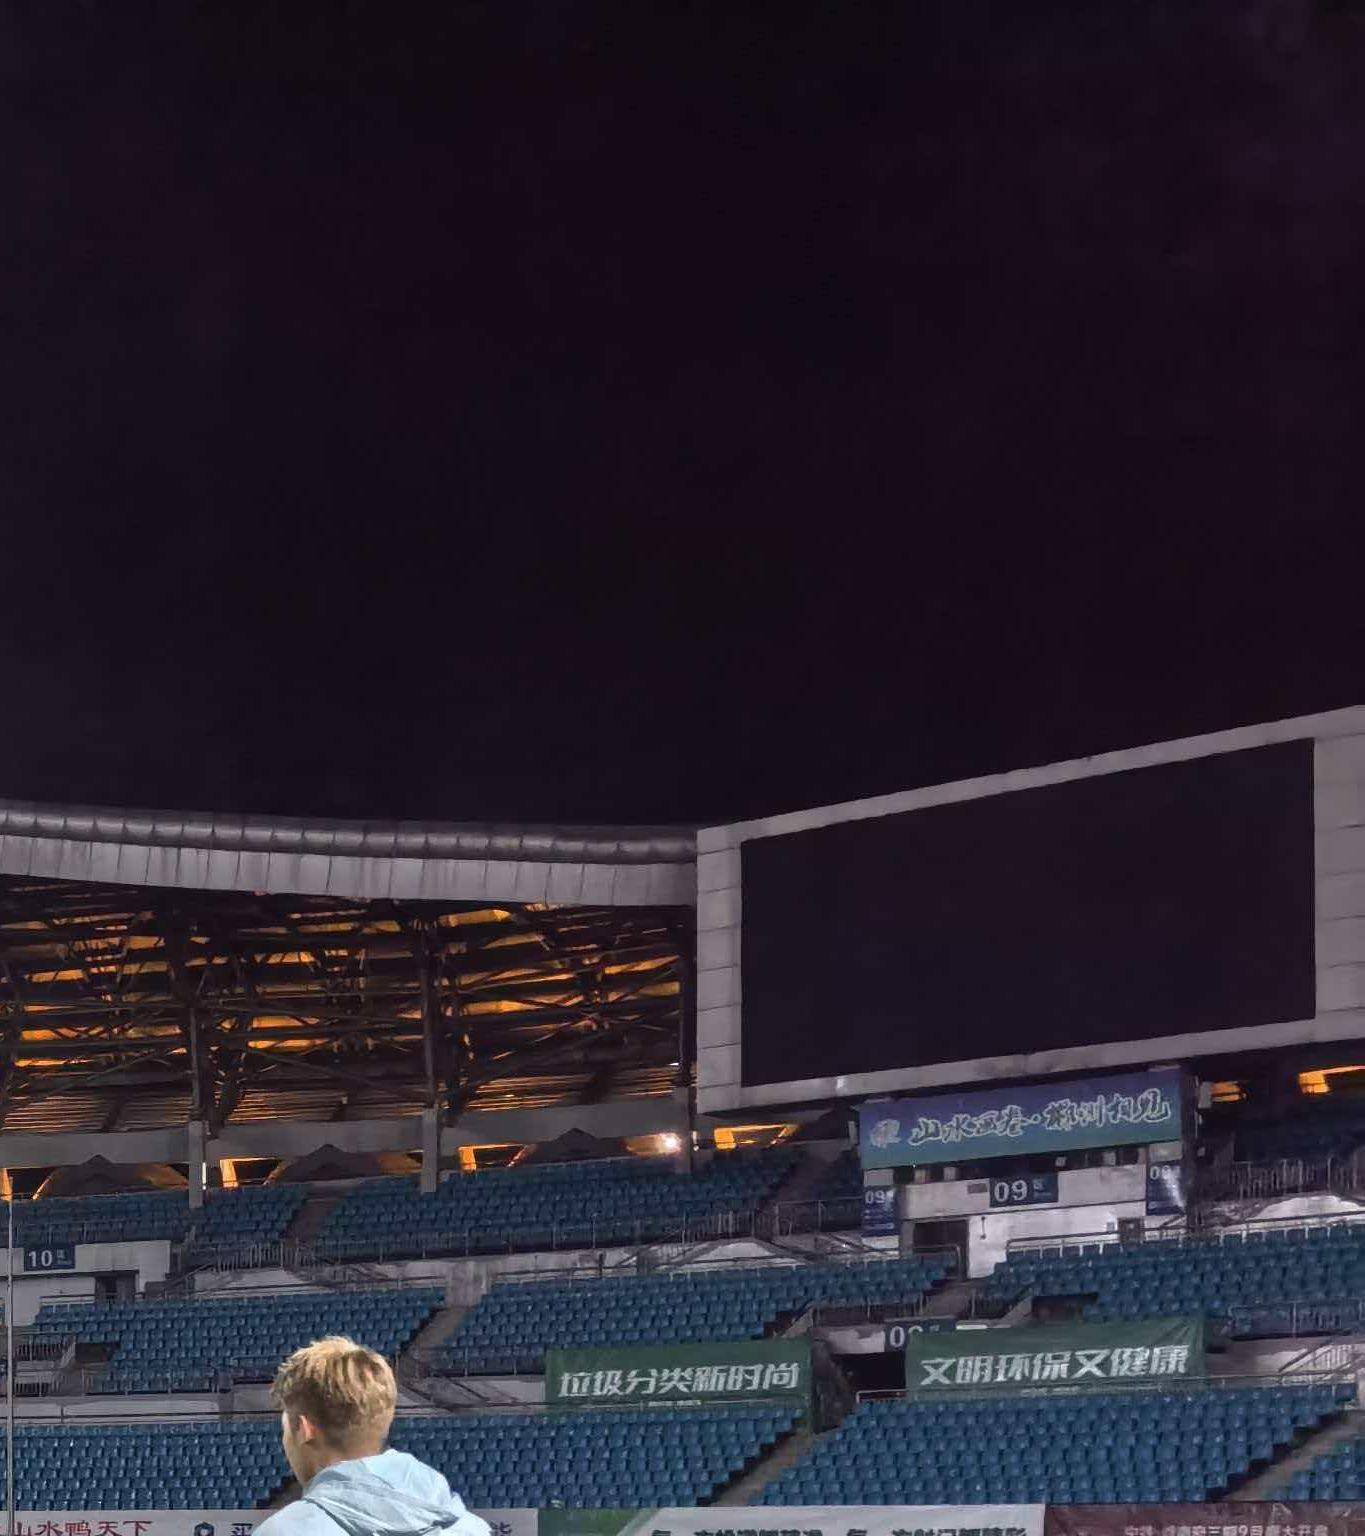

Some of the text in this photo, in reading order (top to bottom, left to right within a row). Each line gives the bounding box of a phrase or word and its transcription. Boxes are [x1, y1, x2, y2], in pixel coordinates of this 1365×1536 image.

[994, 1180, 1028, 1201] 09
[29, 1250, 53, 1267] 10
[920, 1345, 1189, 1386] 文明环保又健康
[558, 1362, 800, 1398] 垃圾分类新时尚
